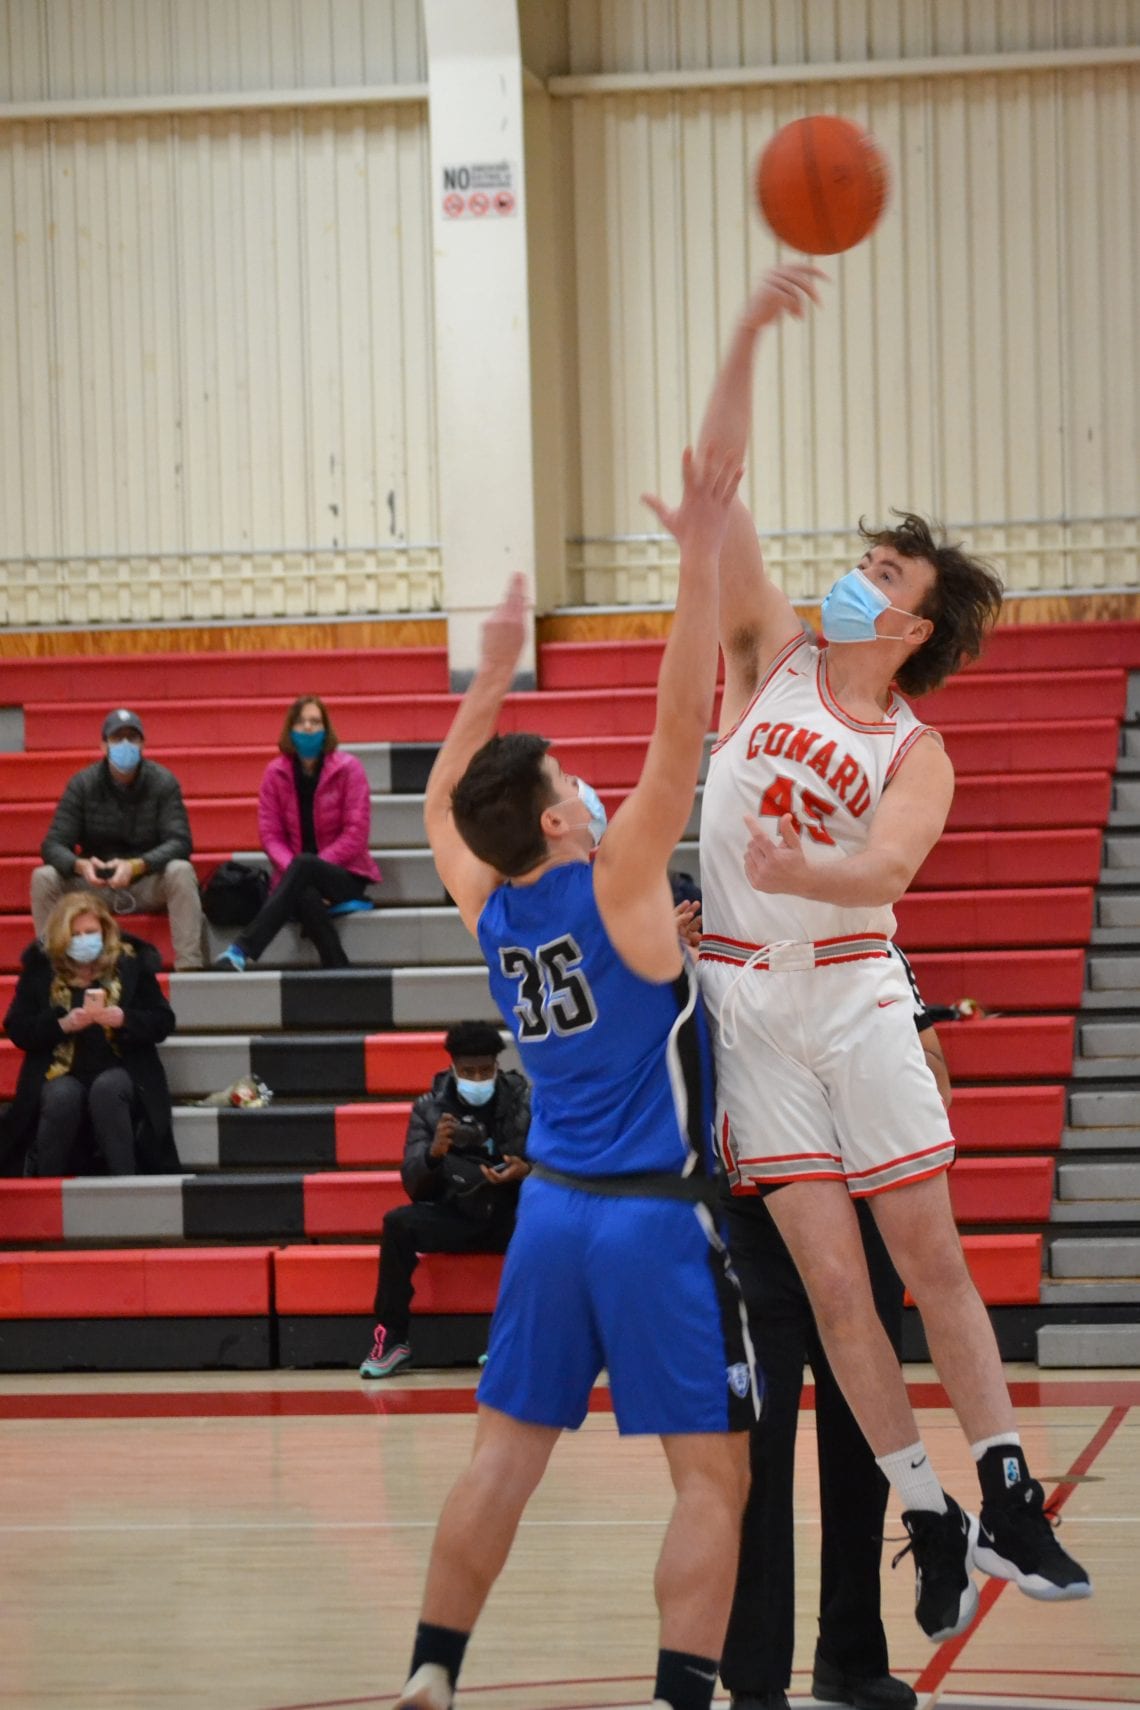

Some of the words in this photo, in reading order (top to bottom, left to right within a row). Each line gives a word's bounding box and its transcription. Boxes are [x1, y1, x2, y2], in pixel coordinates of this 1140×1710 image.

[443, 166, 470, 191] NO
[746, 722, 871, 818] CONARD
[759, 774, 838, 847] 45
[498, 933, 598, 1043] 35
